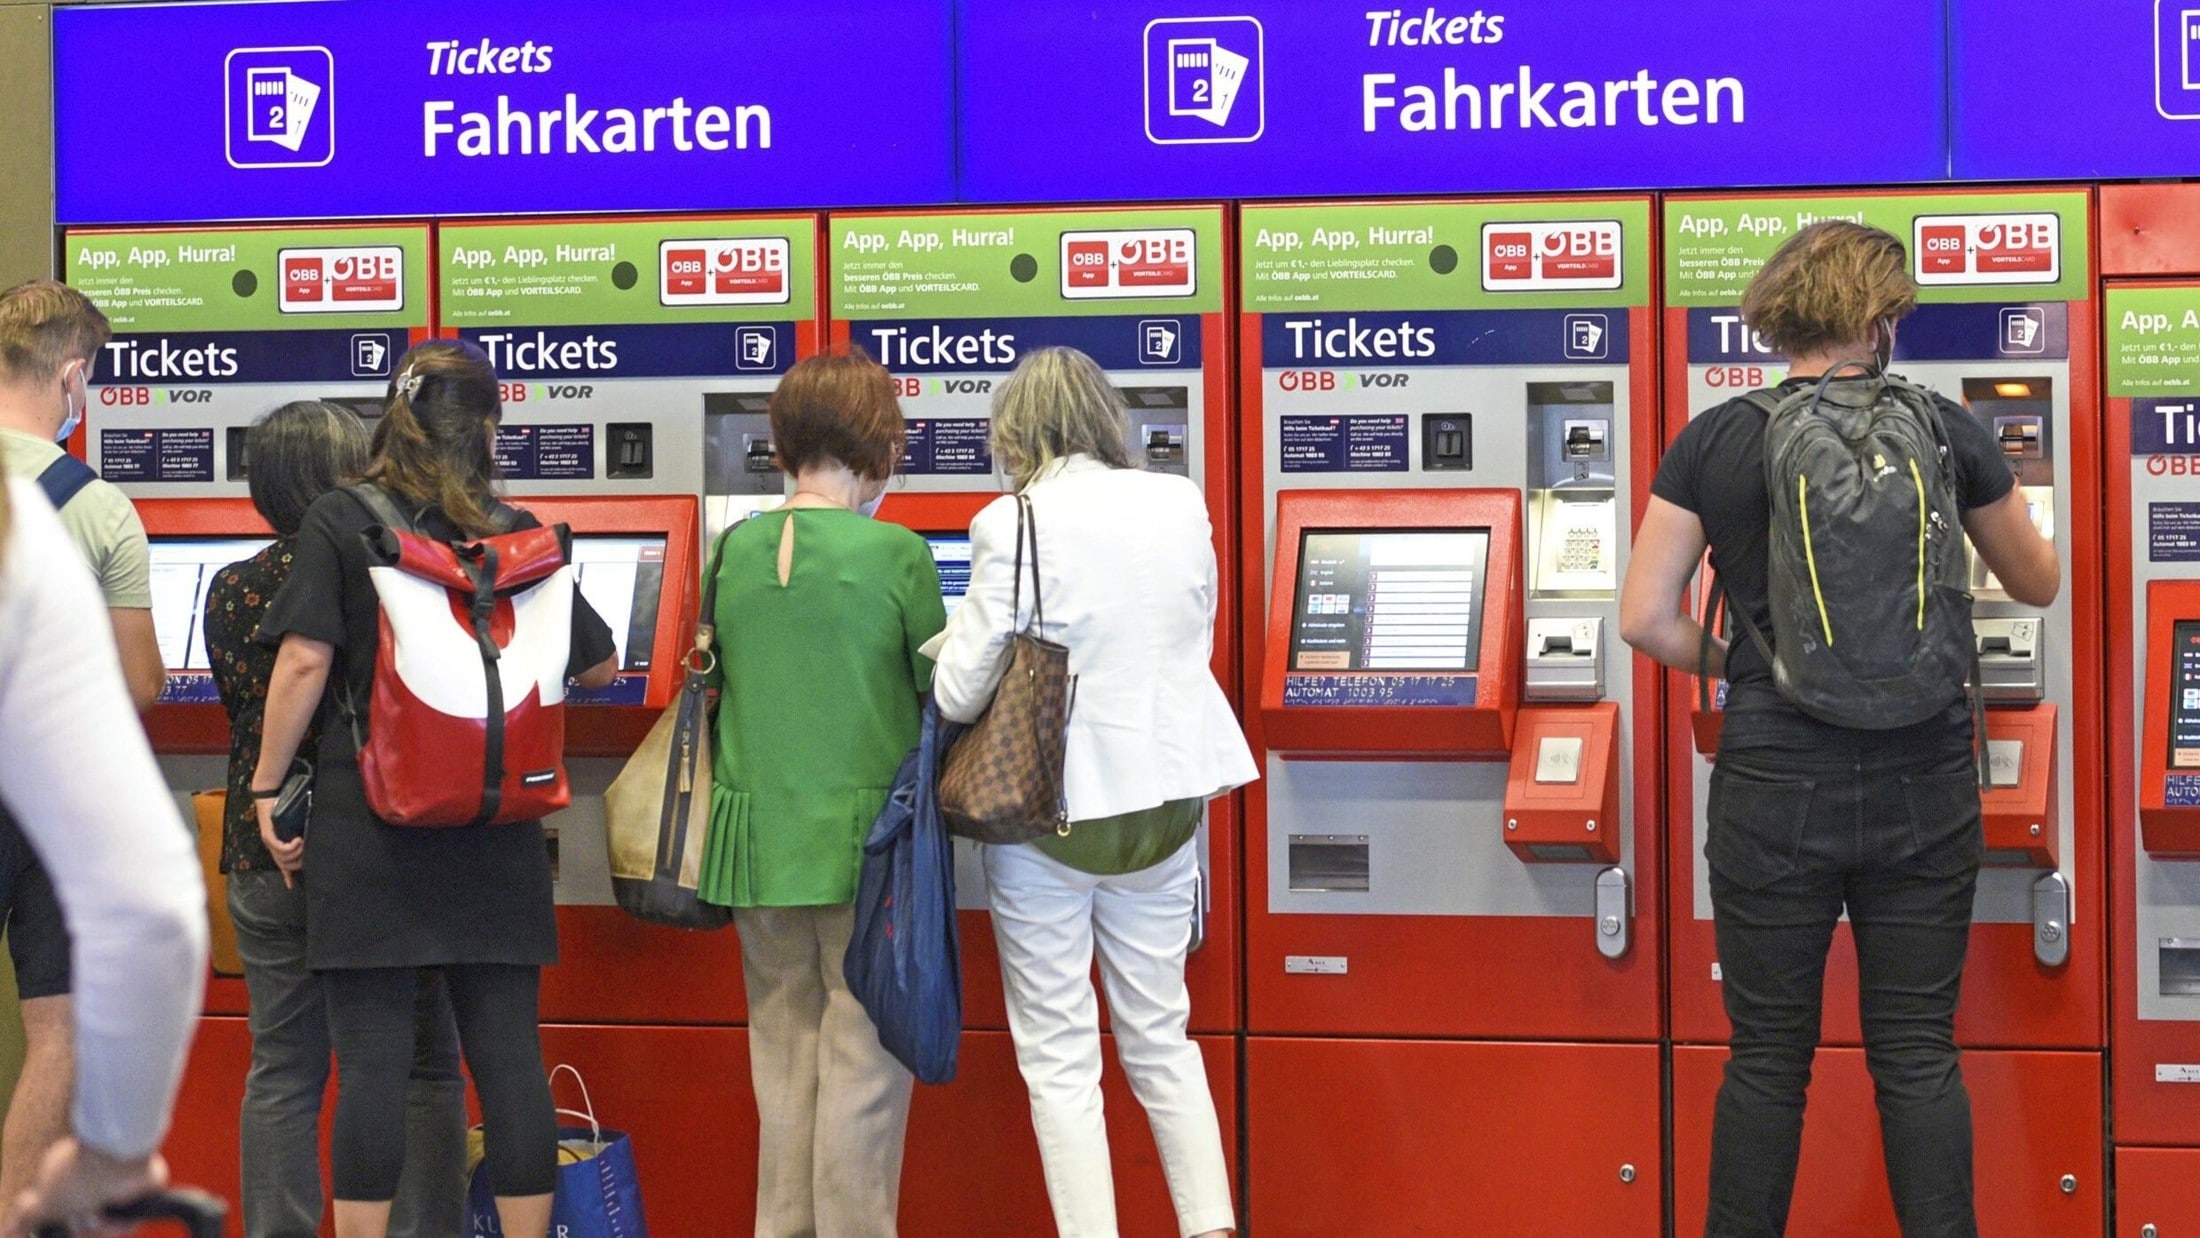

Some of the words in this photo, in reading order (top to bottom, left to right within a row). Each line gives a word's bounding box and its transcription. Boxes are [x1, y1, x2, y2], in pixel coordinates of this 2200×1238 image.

[1365, 7, 1505, 47] Tickets
[425, 37, 552, 76] Tickets
[1363, 65, 1745, 132] Fahrkarten
[423, 93, 772, 157] Fahrkarten
[1679, 215, 1728, 238] App,
[1737, 213, 1787, 237] App,
[843, 231, 889, 254] App,
[897, 229, 944, 252] App,
[952, 227, 1014, 247] Hurra!
[1255, 228, 1304, 252] App,
[1312, 227, 1361, 251] App,
[1369, 226, 1434, 245] Hurra!
[1976, 223, 2051, 250] ÖBB
[1494, 244, 1527, 257] ÖBB
[1541, 231, 1614, 257] ÖBB
[1679, 247, 1698, 255] Jetzt
[1699, 246, 1726, 255] immer
[1727, 245, 1744, 254] den
[1927, 237, 1960, 251] ÖBB
[78, 248, 121, 269] App,
[128, 246, 171, 268] App,
[179, 244, 236, 263] Hurra!
[452, 246, 496, 269] App,
[503, 245, 548, 268] App,
[556, 243, 615, 262] Hurra!
[1072, 252, 1104, 266] ÖBB
[1118, 240, 1188, 265] ÖBB
[844, 262, 861, 270] Jetzt
[888, 261, 904, 269] den
[1256, 259, 1274, 268] Jetzt
[1310, 258, 1326, 267] den
[1328, 257, 1380, 270] Lieblingsplatz
[1504, 263, 1518, 272] App
[1680, 258, 1718, 267] besseren
[1721, 256, 1741, 267] ÖBB
[1743, 257, 1765, 266] Preis
[1936, 256, 1951, 266] App
[452, 277, 469, 285] Jetzt
[502, 276, 517, 284] den
[518, 274, 567, 286] Lieblingsplatz
[844, 272, 880, 281] besseren
[882, 270, 901, 280] ÖBB
[903, 271, 923, 280] Preis
[1256, 271, 1270, 280] Mit
[1272, 269, 1290, 280] ÖBB
[1292, 271, 1311, 282] App
[1312, 270, 1328, 279] und
[1330, 269, 1399, 279] VORTEILSCARD.
[1680, 270, 1694, 279] Mit
[1695, 268, 1715, 279] ÖBB
[1717, 269, 1736, 281] App
[1738, 269, 1754, 278] und
[114, 285, 131, 296] ÖBB
[133, 286, 152, 296] Preis
[453, 288, 465, 296] Mit
[467, 286, 484, 296] ÖBB
[486, 287, 504, 298] App
[505, 287, 520, 295] und
[844, 285, 857, 294] Mit
[859, 283, 877, 293] ÖBB
[879, 284, 898, 295] App
[899, 283, 914, 292] und
[111, 299, 127, 309] App
[129, 298, 143, 307] und
[1294, 292, 1319, 301] oebb.at
[2121, 310, 2173, 335] App,
[1285, 316, 1437, 358] Tickets
[479, 331, 618, 371] Tickets
[871, 324, 1017, 366] Tickets
[2121, 343, 2141, 352] Jetzt
[2180, 342, 2197, 351] den
[104, 339, 238, 378] Tickets
[2122, 355, 2136, 364] Mit
[2138, 353, 2159, 364] ÖBB
[2161, 354, 2181, 366] App
[2183, 354, 2200, 363] und
[1279, 370, 1336, 391] ÖBB
[1359, 373, 1410, 388] VOR
[1704, 366, 1763, 388] ÖBB
[2162, 378, 2190, 386] oebb.at
[498, 383, 526, 402] BB
[548, 385, 594, 399] VOR
[944, 379, 992, 394] VOR
[100, 386, 149, 406] ÖBB
[169, 389, 213, 403] VOR
[1286, 677, 1325, 687] HILFE?
[1333, 677, 1386, 687] TELEFON
[1391, 677, 1404, 687] 05
[1441, 677, 1455, 687] 25
[1285, 687, 1340, 697] AUTOMAT
[1348, 687, 1375, 697] 1003
[1379, 687, 1394, 698] 95
